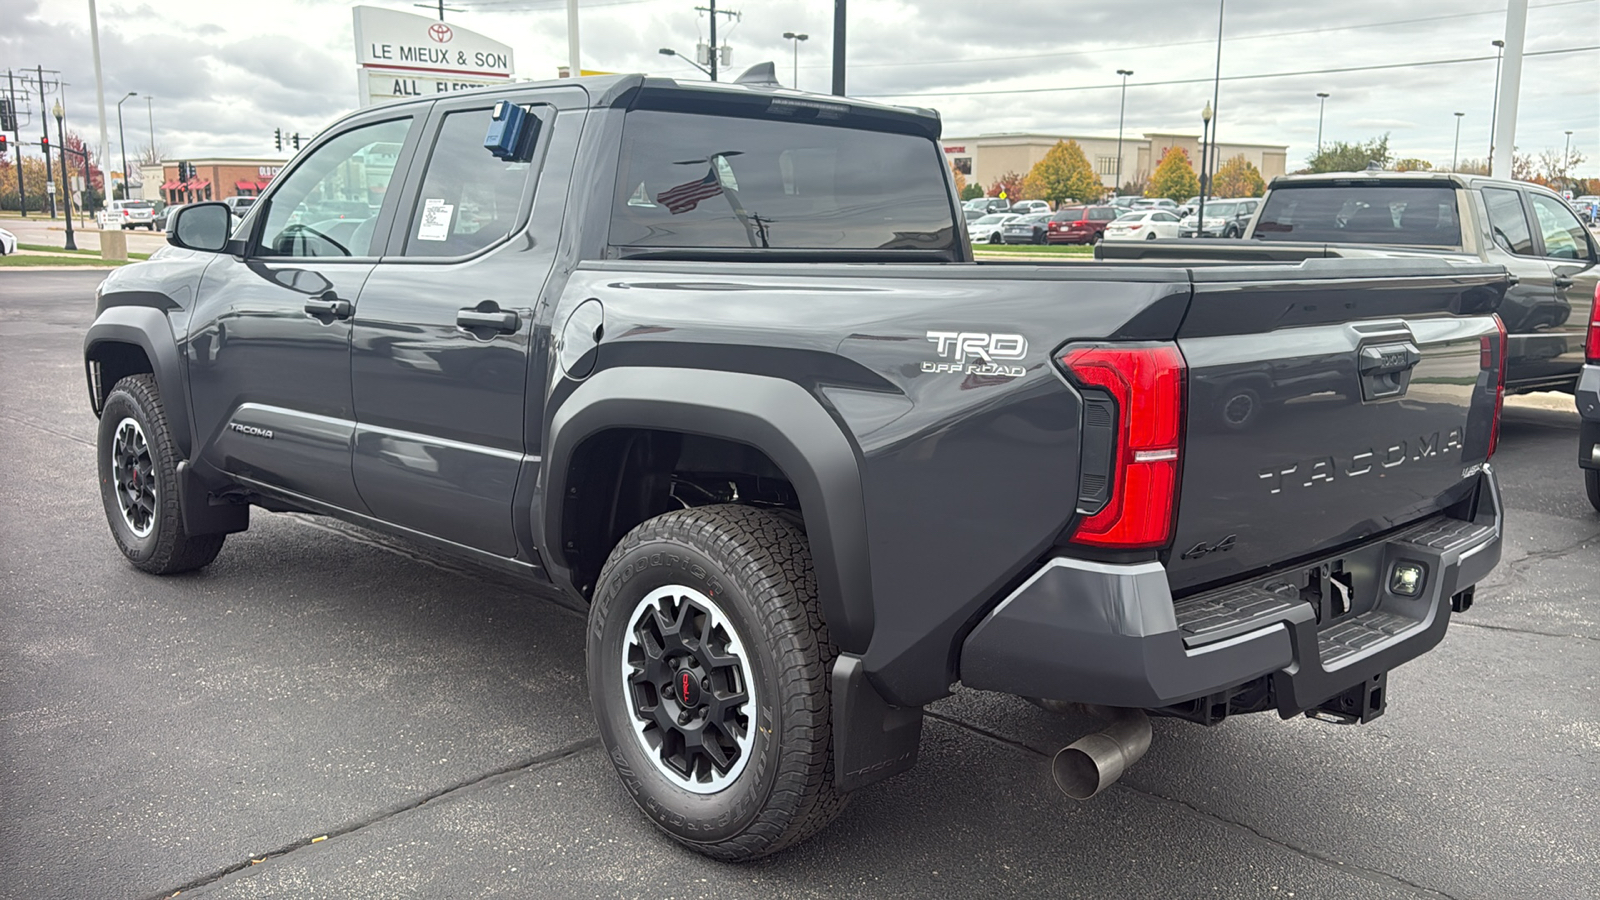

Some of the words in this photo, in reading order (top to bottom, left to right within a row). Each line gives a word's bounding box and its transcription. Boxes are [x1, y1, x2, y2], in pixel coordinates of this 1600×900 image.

[372, 43, 392, 59] LE
[400, 46, 450, 64] MIEUX
[457, 51, 468, 65] &
[475, 52, 508, 69] SON
[393, 79, 421, 95] ALL
[926, 331, 1028, 364] TRD
[921, 361, 962, 374] OFF
[965, 363, 1026, 376] ROAD
[229, 422, 274, 439] TACOMA
[1258, 426, 1464, 494] TACOMA
[594, 550, 724, 640] BFGoodrich
[682, 673, 690, 702] TRD
[612, 746, 643, 796] T/A
